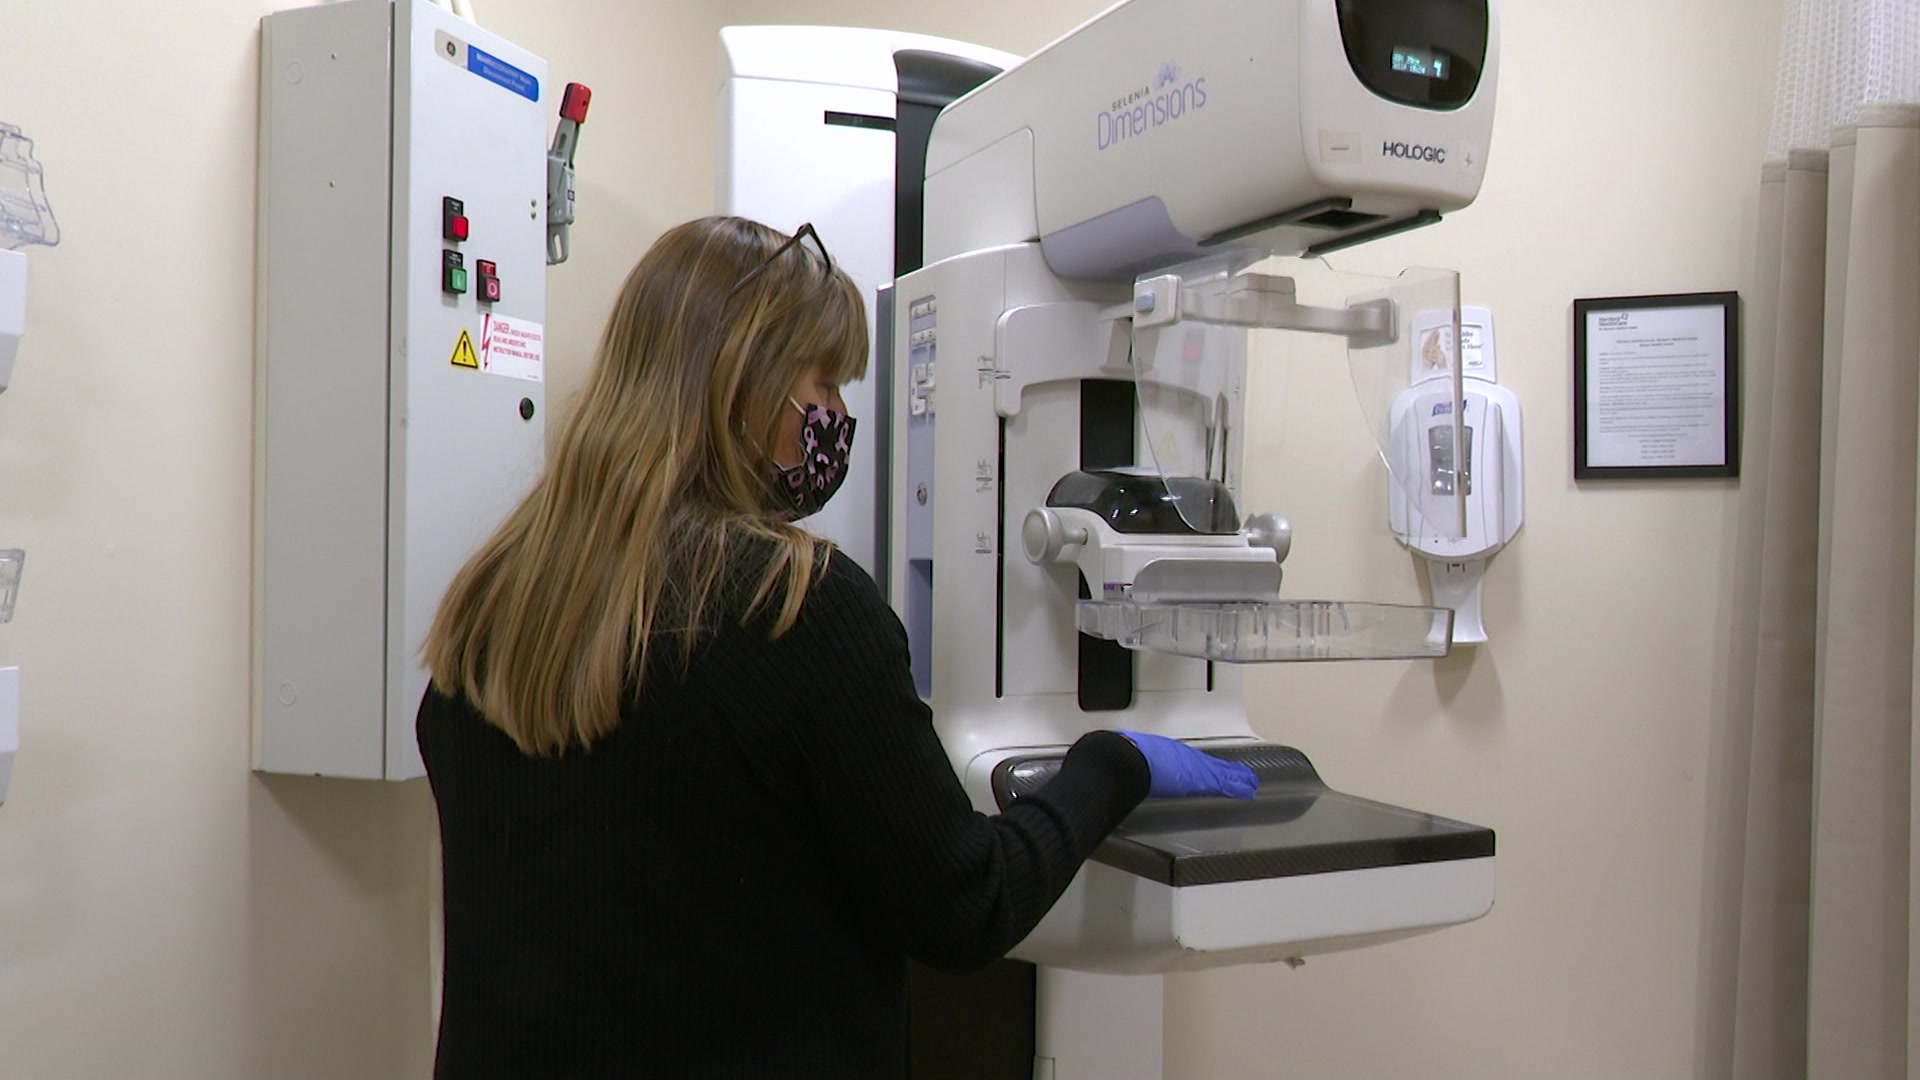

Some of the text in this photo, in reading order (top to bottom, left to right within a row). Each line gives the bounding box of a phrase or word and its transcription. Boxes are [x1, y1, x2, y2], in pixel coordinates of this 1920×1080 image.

[1111, 85, 1151, 112] SELENIA
[1097, 77, 1207, 150] Dimensions
[1382, 141, 1446, 164] HOLOGIC
